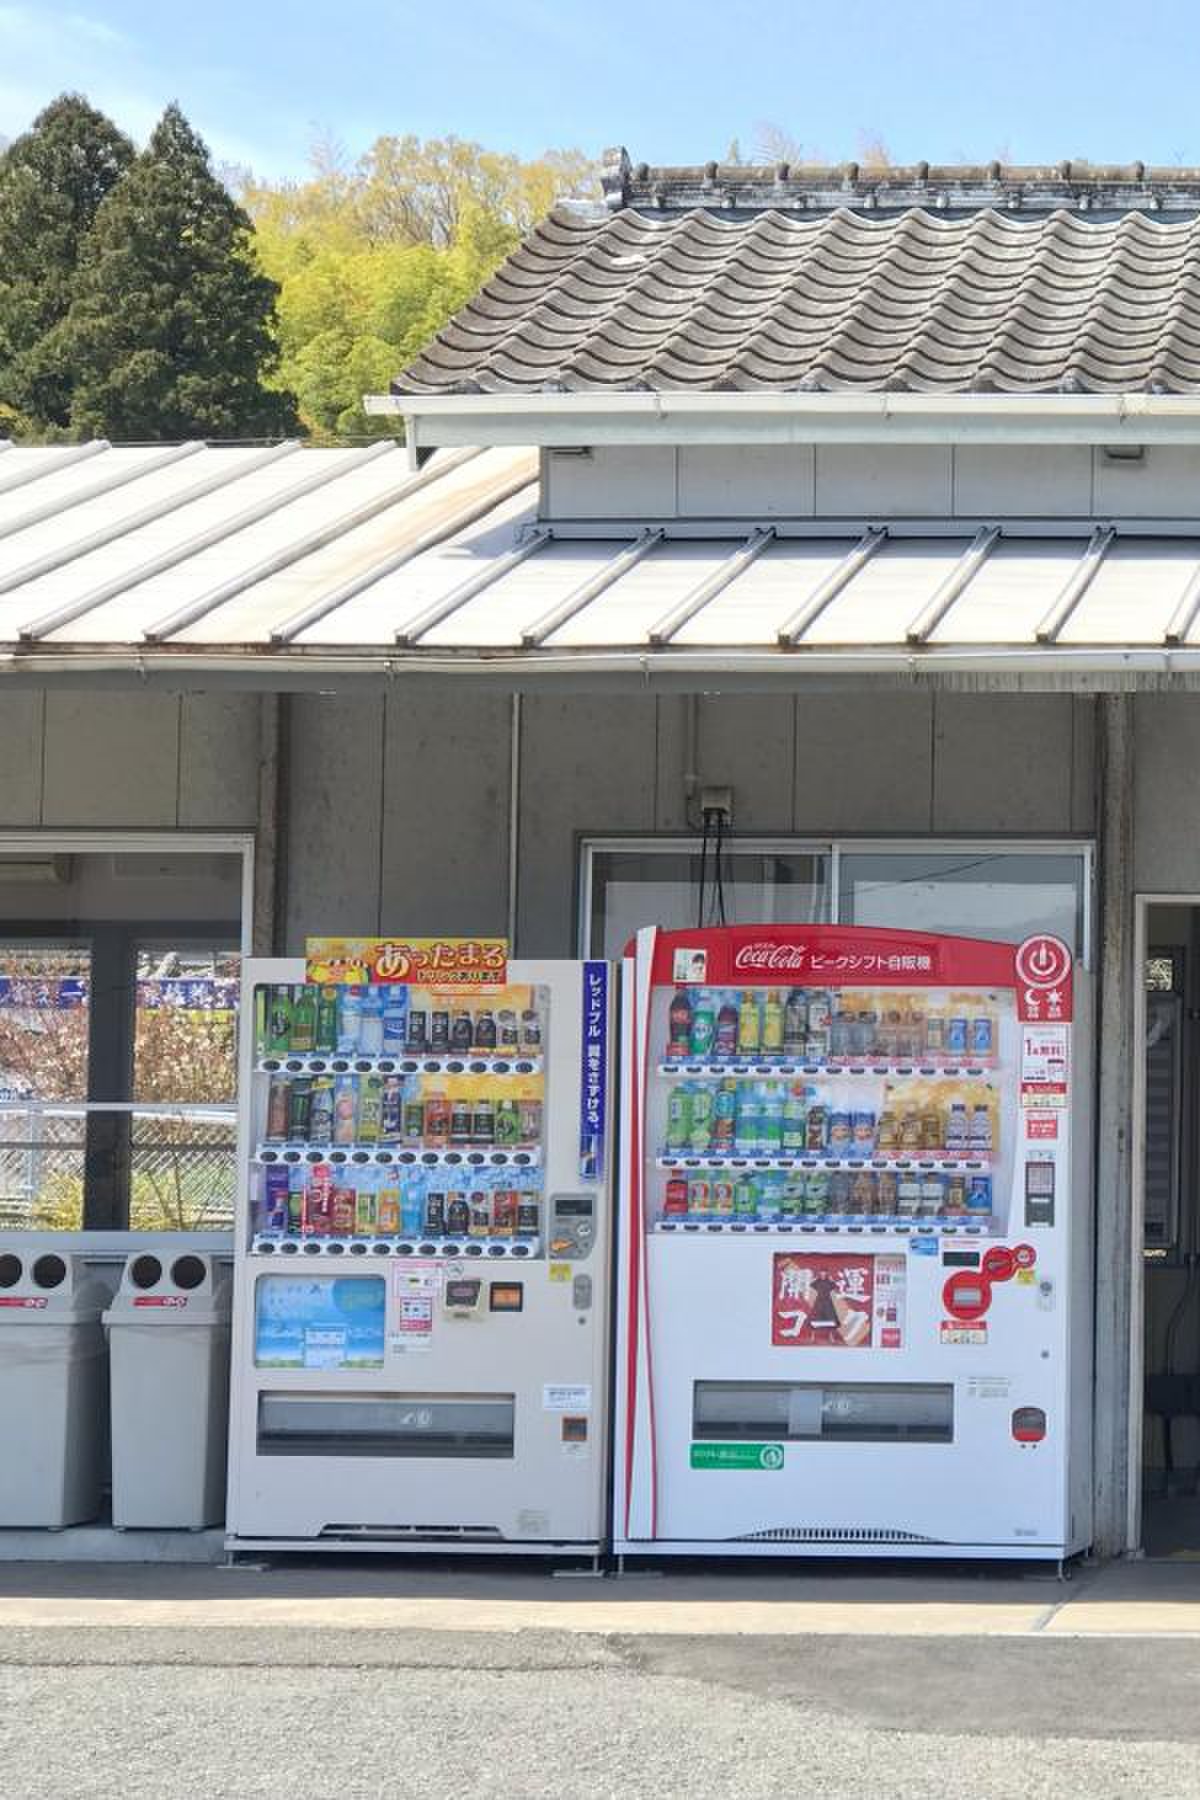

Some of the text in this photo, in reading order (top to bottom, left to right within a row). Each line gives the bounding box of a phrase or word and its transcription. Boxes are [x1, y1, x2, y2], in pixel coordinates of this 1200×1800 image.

[375, 942, 505, 977] あったまる
[735, 943, 806, 969] Coca-Cola
